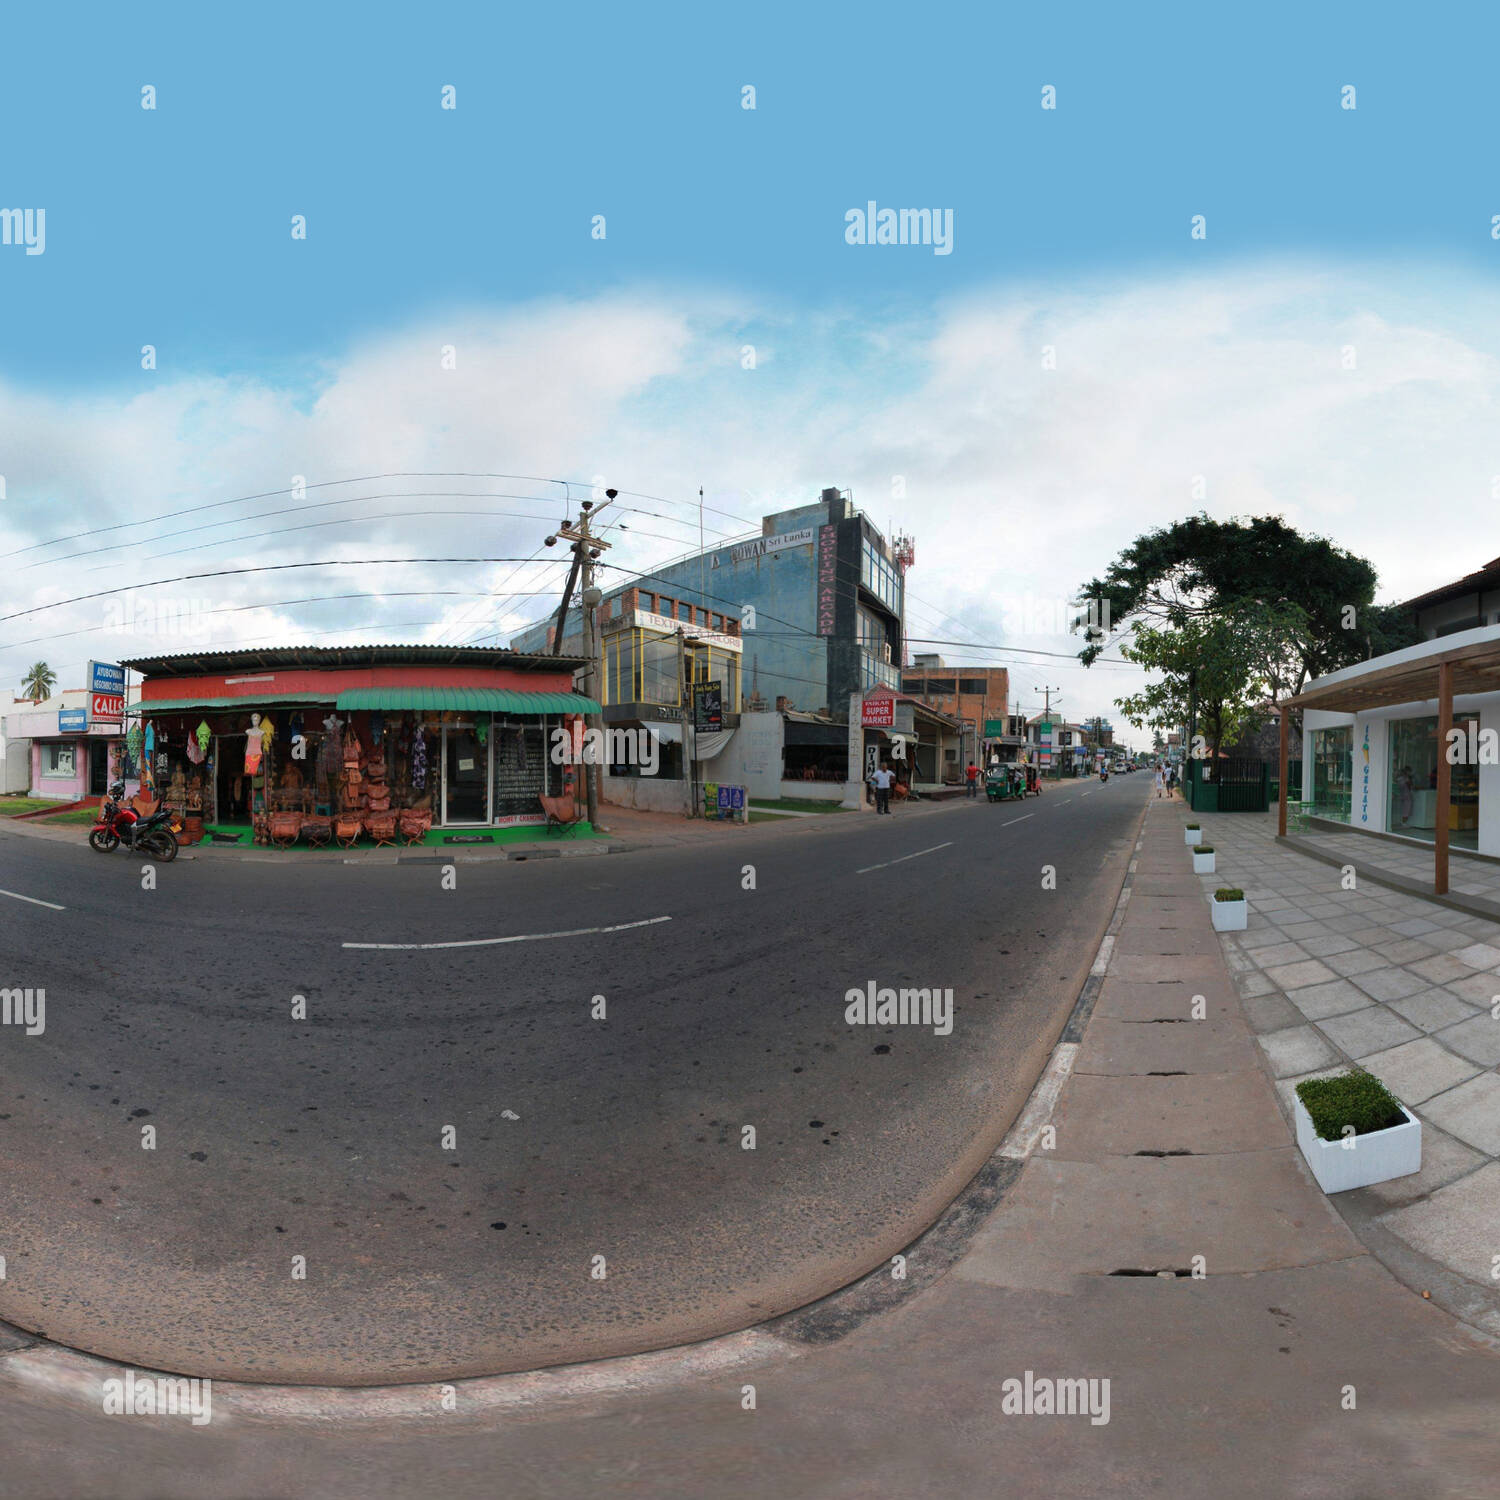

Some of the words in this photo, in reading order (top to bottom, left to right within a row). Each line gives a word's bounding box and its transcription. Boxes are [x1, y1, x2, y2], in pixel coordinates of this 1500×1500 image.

[768, 538, 780, 546] Sri
[784, 531, 811, 544] Lanka
[94, 697, 123, 714] CALLS
[866, 706, 889, 715] SUPER
[862, 715, 892, 724] MARKET
